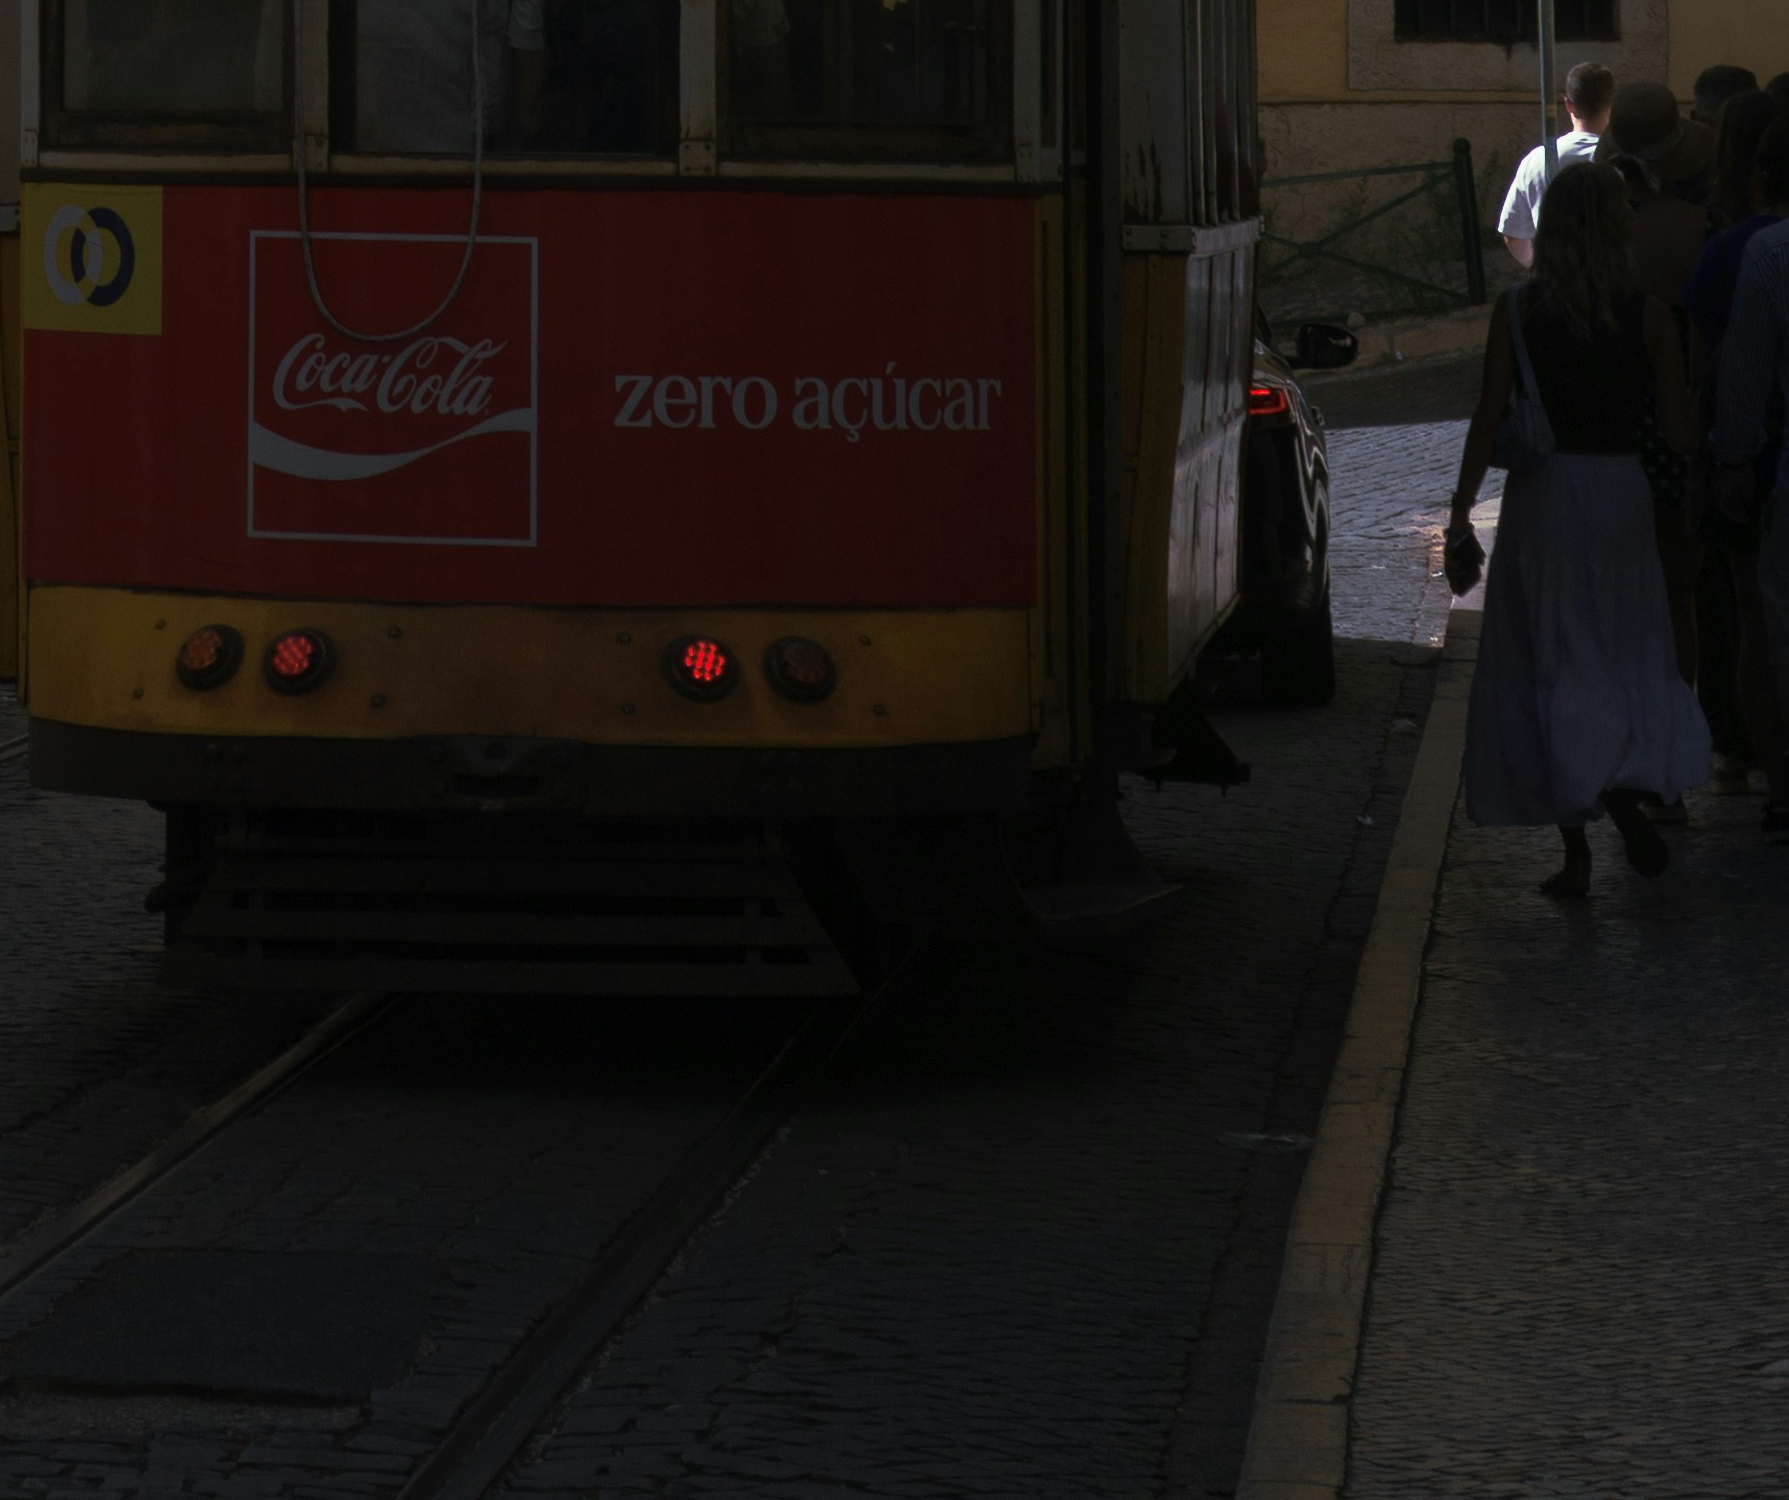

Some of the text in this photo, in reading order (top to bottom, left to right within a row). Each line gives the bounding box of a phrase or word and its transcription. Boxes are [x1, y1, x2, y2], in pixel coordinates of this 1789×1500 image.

[272, 332, 510, 417] Coca-Cola
[612, 360, 1003, 445] zero açúcar
